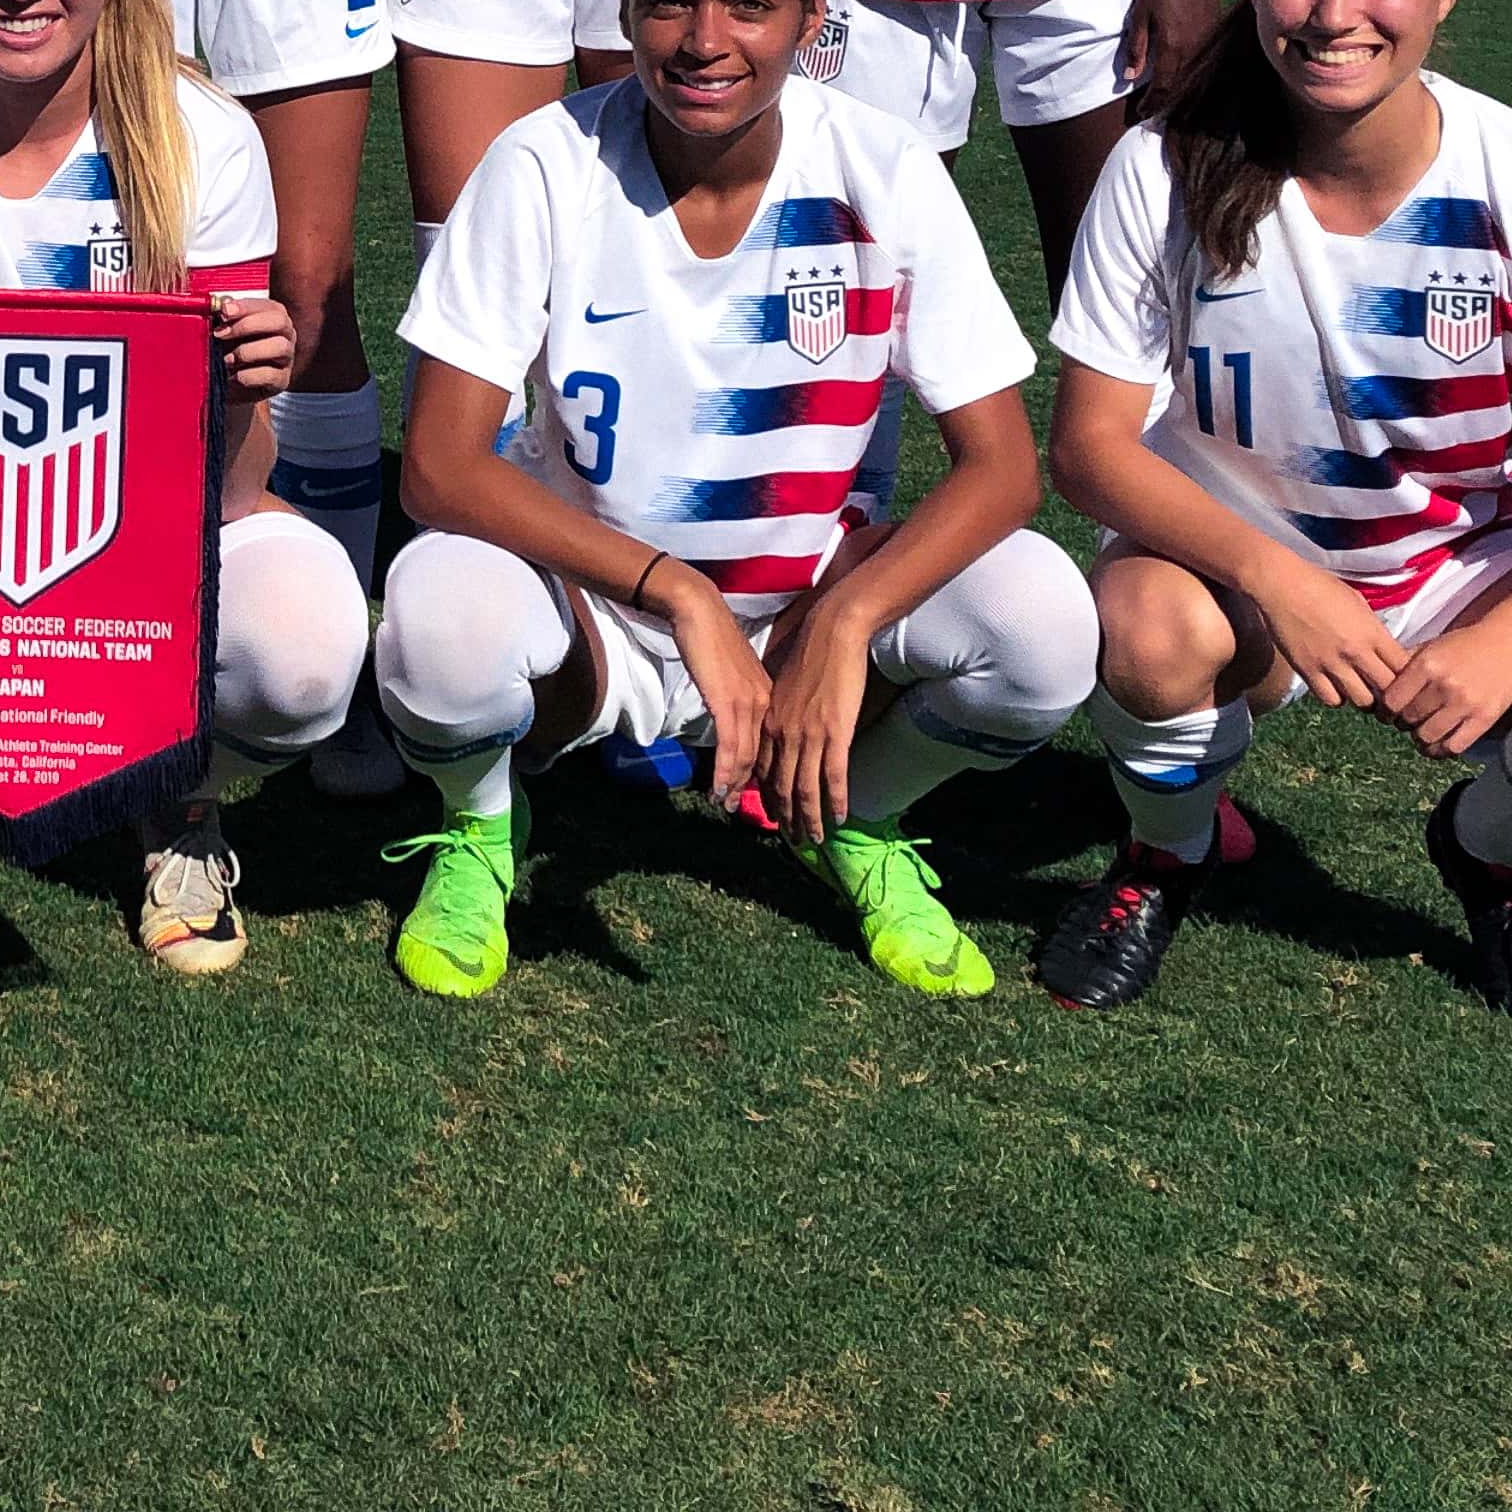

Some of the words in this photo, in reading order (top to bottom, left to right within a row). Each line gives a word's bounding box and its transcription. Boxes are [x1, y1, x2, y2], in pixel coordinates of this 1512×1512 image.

[818, 24, 843, 47] SA
[792, 290, 840, 317] USA
[1431, 294, 1487, 320] USA
[1188, 346, 1254, 449] 11
[563, 370, 621, 486] 3
[1, 615, 65, 636] SOCCER
[74, 618, 172, 640] FEDERATION
[17, 639, 101, 660] NATIONAL
[104, 642, 152, 662] TEAM
[50, 709, 105, 728] Friendly
[39, 740, 85, 756] Training
[86, 742, 124, 756] Center
[22, 756, 76, 770] California
[34, 770, 60, 785] 2019
